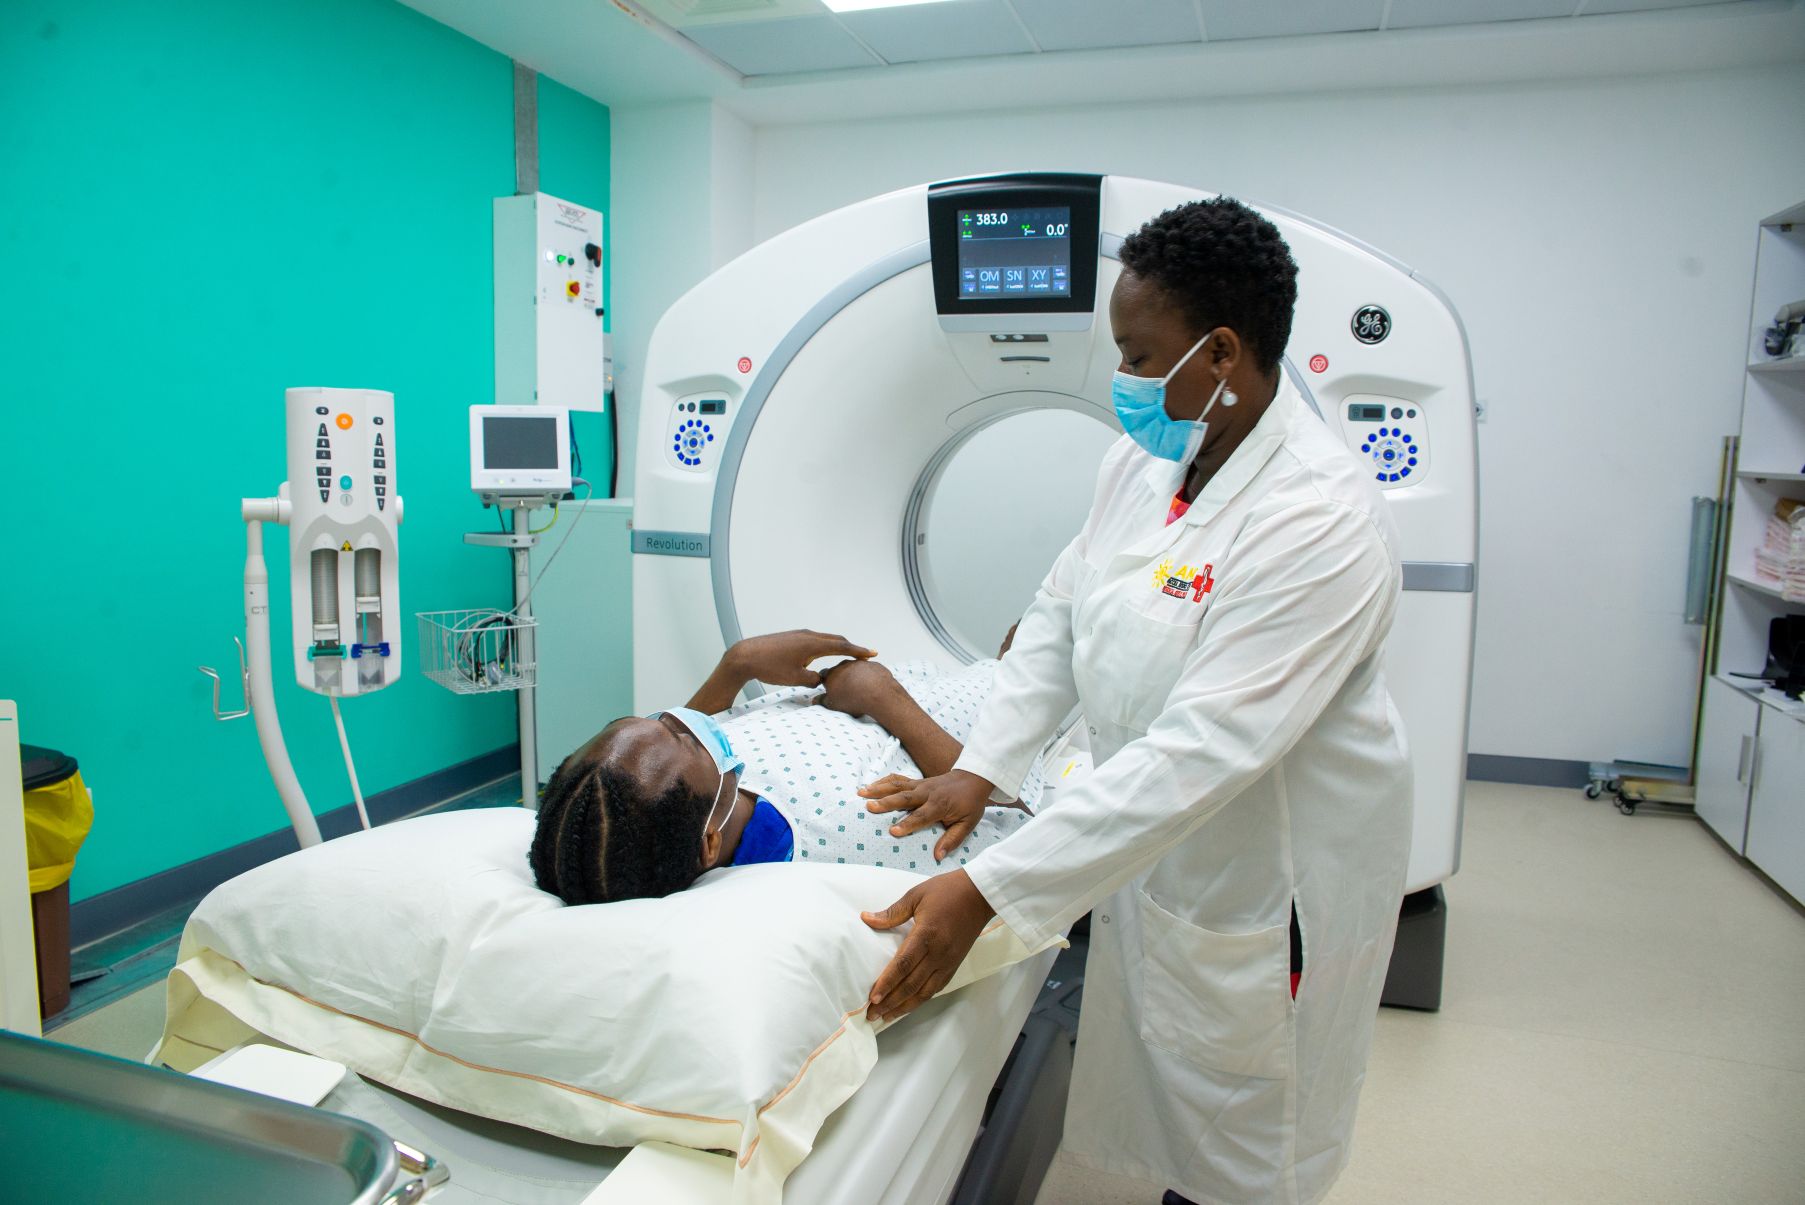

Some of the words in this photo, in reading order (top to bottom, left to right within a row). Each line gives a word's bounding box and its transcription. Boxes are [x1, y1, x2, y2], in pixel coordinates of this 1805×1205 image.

[976, 213, 1008, 225] 383.0
[980, 271, 1000, 281] OM
[1007, 270, 1022, 281] SN
[1032, 269, 1047, 280] XY
[646, 537, 703, 551] Revolution
